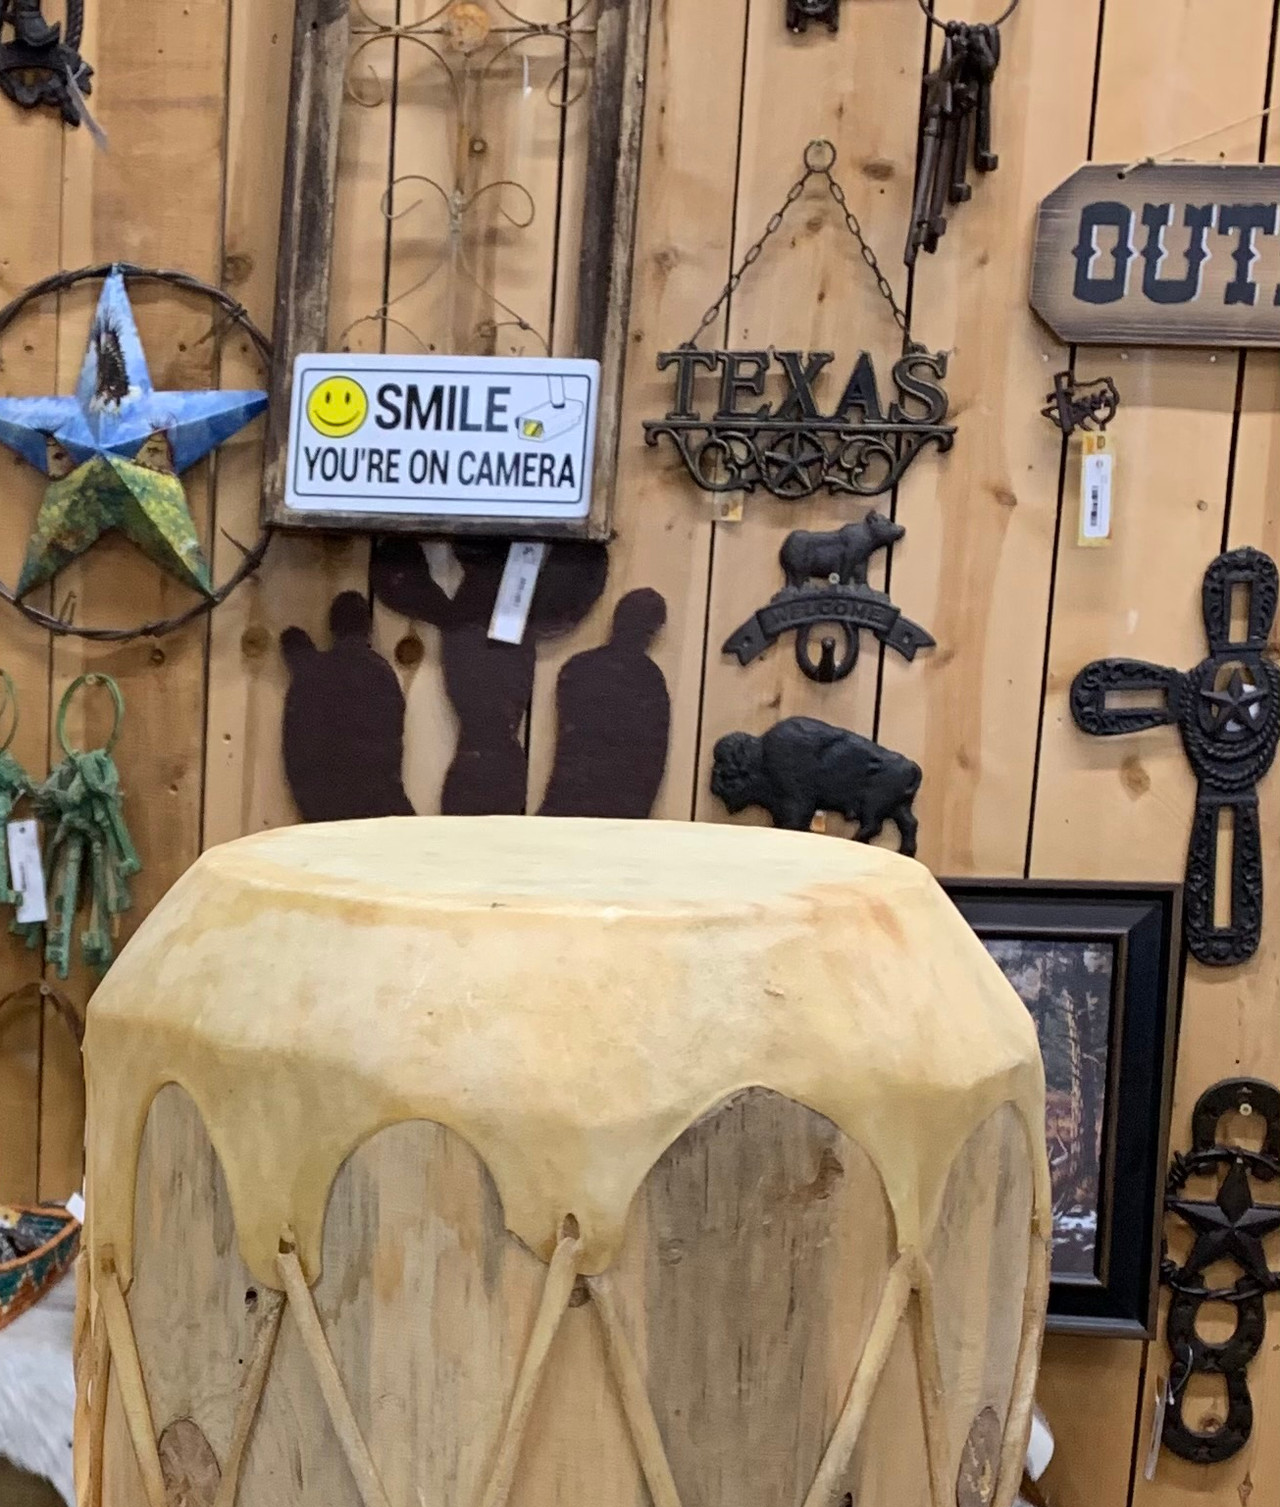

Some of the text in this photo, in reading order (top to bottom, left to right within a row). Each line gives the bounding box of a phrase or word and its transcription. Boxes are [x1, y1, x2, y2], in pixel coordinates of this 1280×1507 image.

[1071, 201, 1280, 306] OUT
[374, 383, 511, 432] SMILE
[656, 350, 949, 424] TEXAS
[305, 446, 575, 488] YOU'RE ON CAMERA
[772, 598, 885, 622] WELCOME
